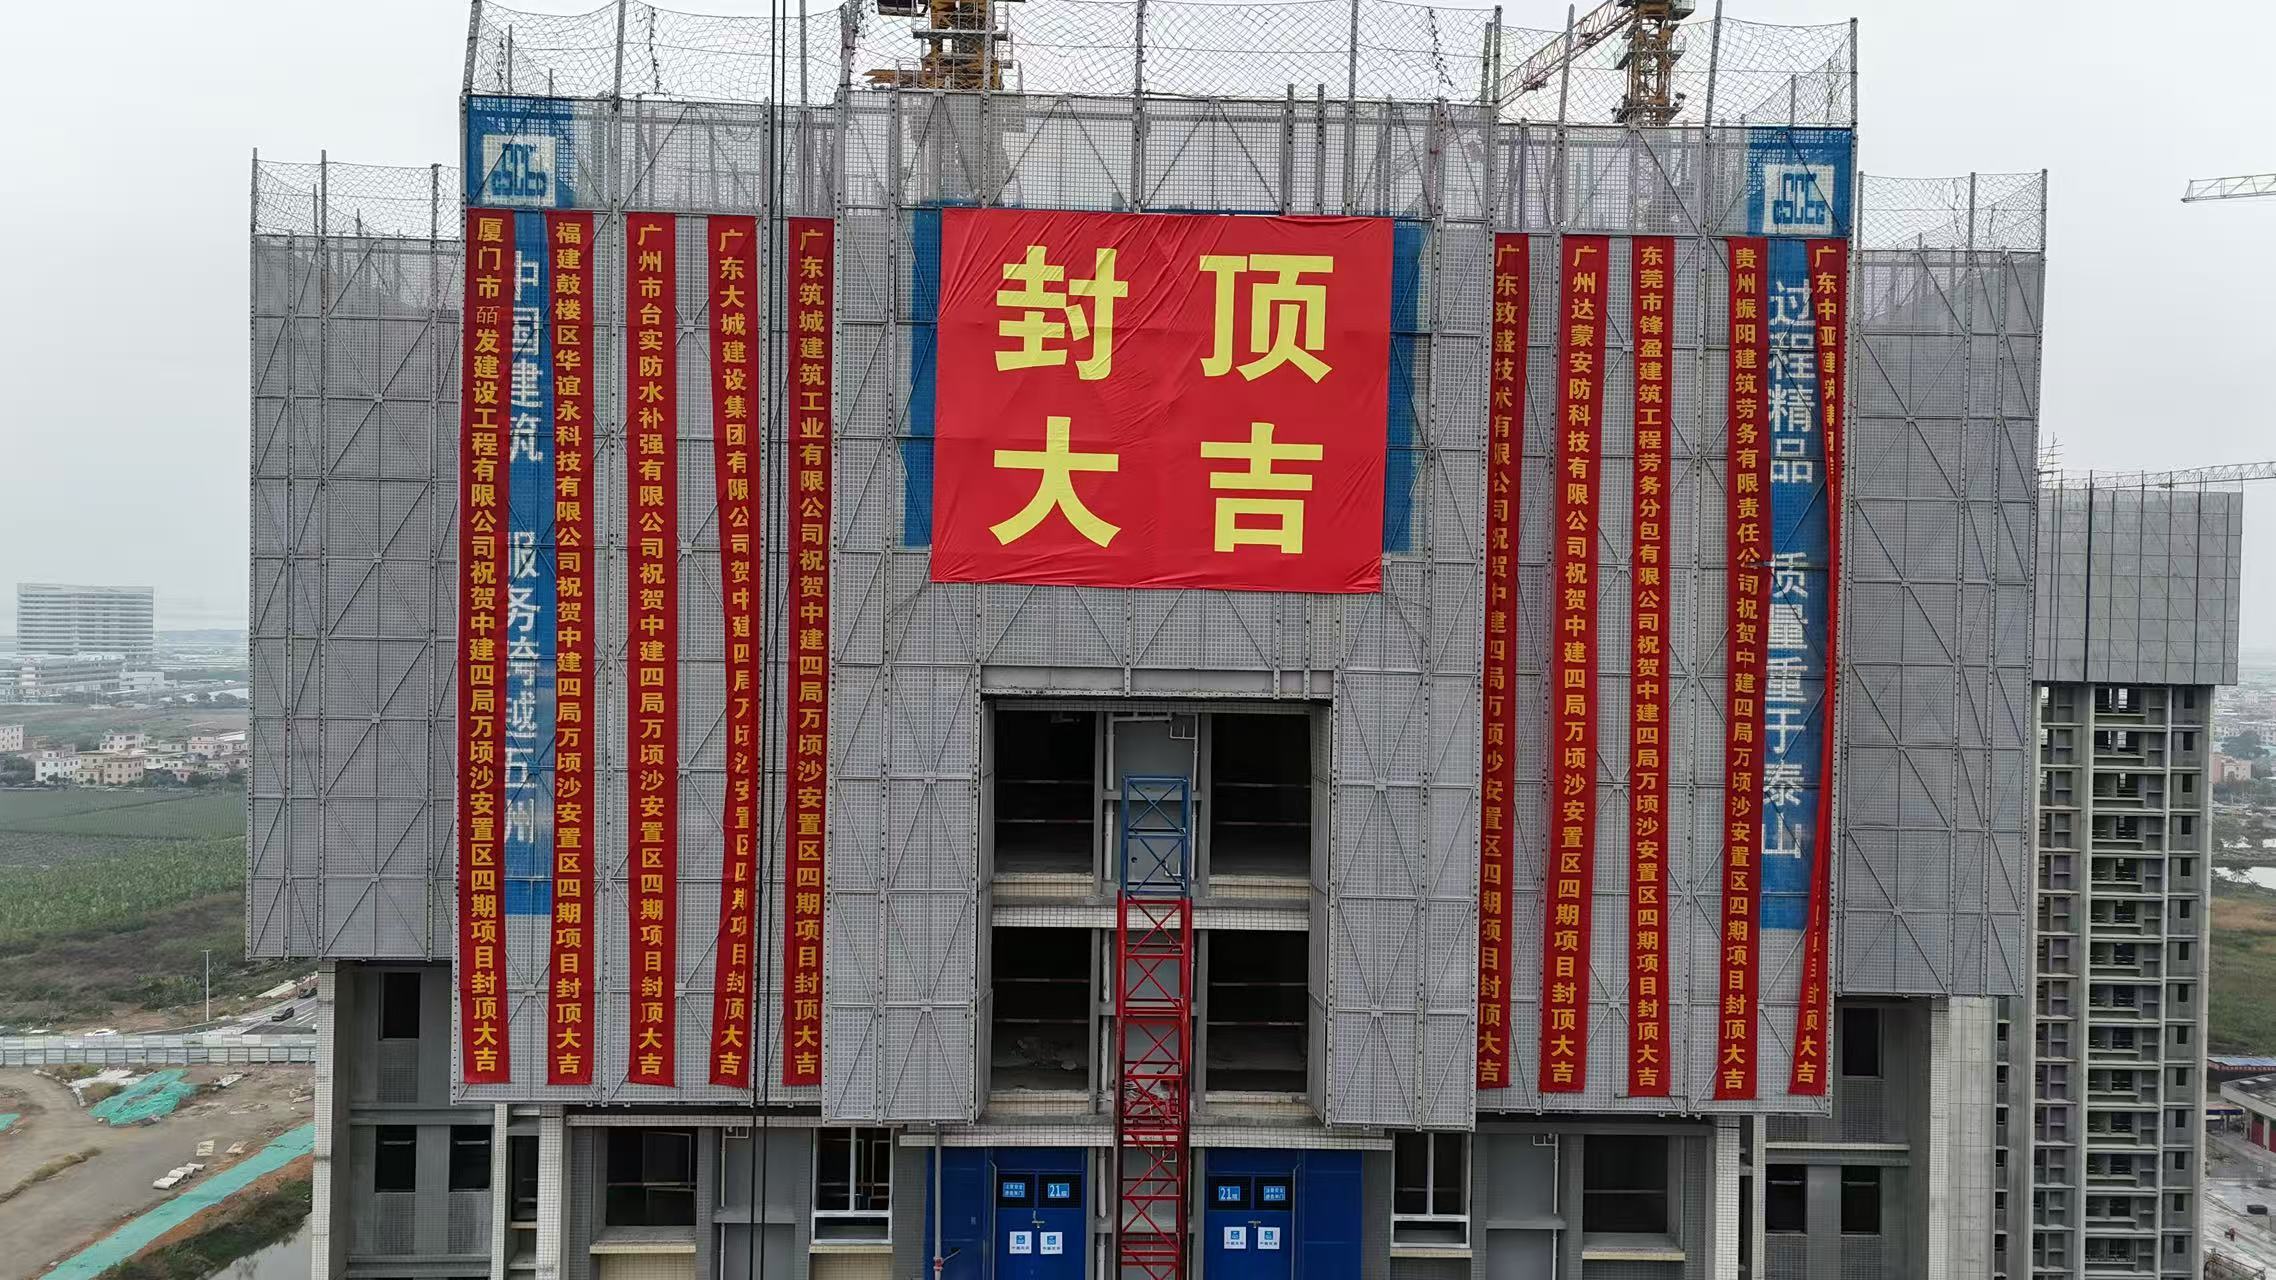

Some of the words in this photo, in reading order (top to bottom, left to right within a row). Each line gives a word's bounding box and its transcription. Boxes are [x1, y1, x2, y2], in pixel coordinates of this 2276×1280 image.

[510, 250, 543, 463] 中国建筑
[555, 221, 583, 1075] 福建鼓楼区华谊永科技有限公司祝贺中建四局万顷沙安置区四期项目封顶大吉
[637, 223, 665, 1075] 广州市台实防水补强有限公司祝贺中建四局万顷沙安置区四期项目封顶大吉
[794, 228, 825, 1075] 广东筑城建筑工业有限公司祝贺中建四局万顷沙安置区四期项目封顶大吉
[988, 416, 1323, 554] 大吉
[995, 246, 1334, 383] 封顶
[1551, 245, 1598, 1083] 广州达蒙安防科技有限公司祝贺中建四局万顷沙安置区四期项目封顶大吉
[1636, 247, 1664, 1087] 东莞市锋盈建筑工程劳务分包有限公司祝贺中建四局万顷沙安置区四期项目封顶大吉
[1723, 247, 1760, 1089] 贵州振阳建筑劳务有限责任公司祝贺中建四局万顷沙安置区四期项目封顶大吉
[1761, 552, 1808, 858] 质量重于泰山
[1768, 279, 1816, 483] 过程精品
